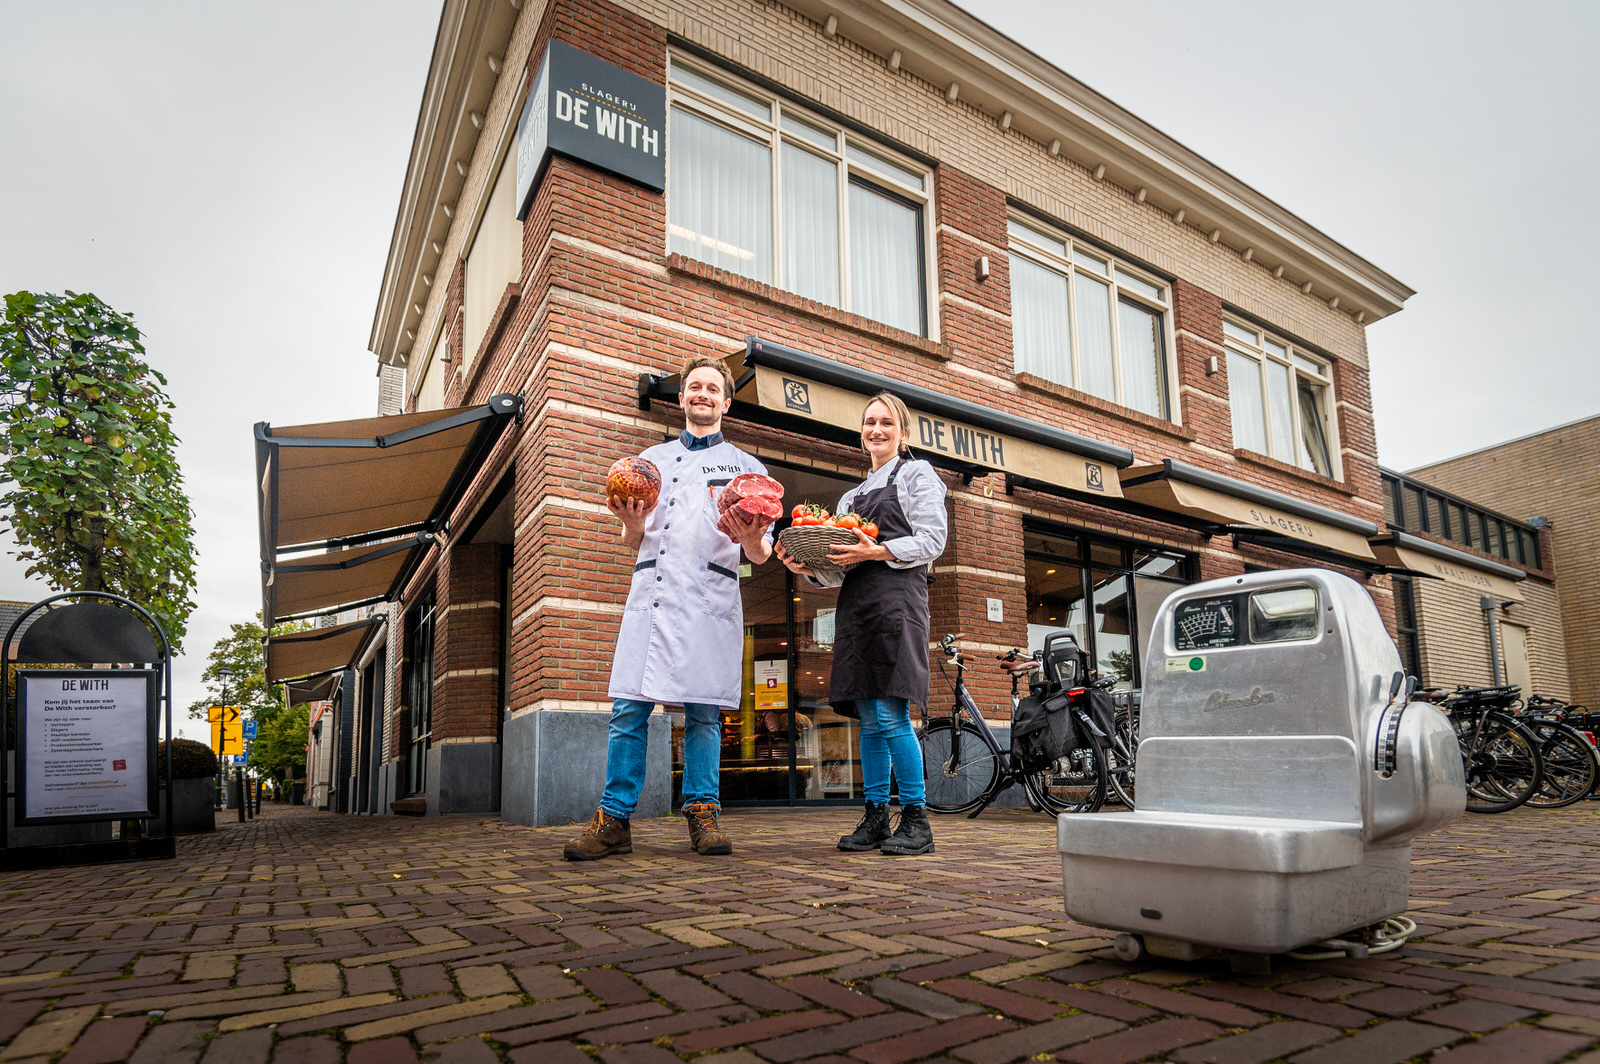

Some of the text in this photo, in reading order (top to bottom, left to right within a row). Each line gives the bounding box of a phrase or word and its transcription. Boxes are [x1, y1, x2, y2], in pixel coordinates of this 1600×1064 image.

[582, 82, 637, 111] SLAGERIJ
[556, 90, 589, 130] DE
[596, 105, 659, 157] WITH
[918, 416, 1005, 466] DE WITH
[717, 464, 740, 473] With
[62, 680, 108, 690] DE WITH
